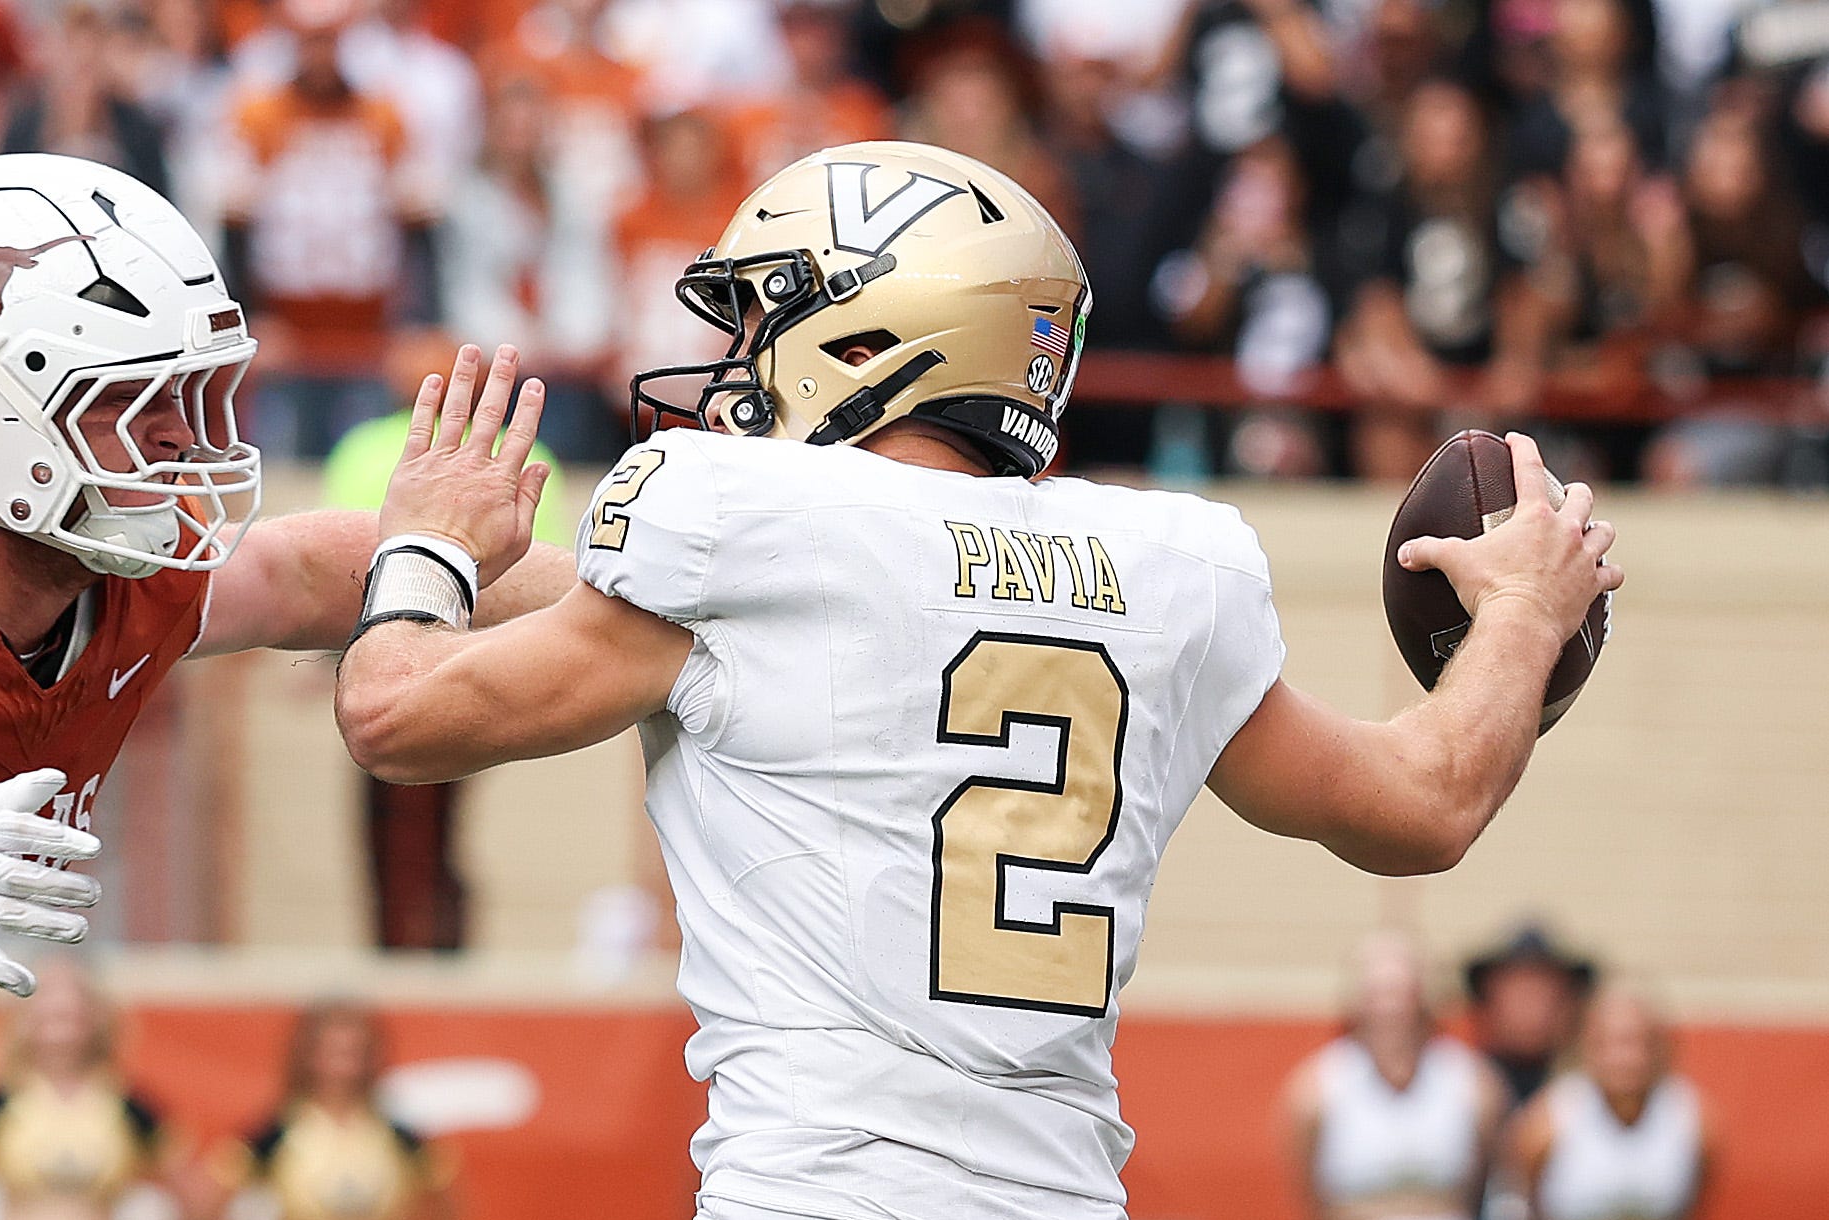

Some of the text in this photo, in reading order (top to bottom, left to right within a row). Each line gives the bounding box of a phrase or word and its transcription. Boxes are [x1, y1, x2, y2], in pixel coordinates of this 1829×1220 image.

[823, 162, 969, 259] V
[1027, 355, 1054, 394] SEC
[589, 448, 665, 553] 2
[944, 519, 1126, 615] PAVIA
[929, 630, 1129, 1019] 2
